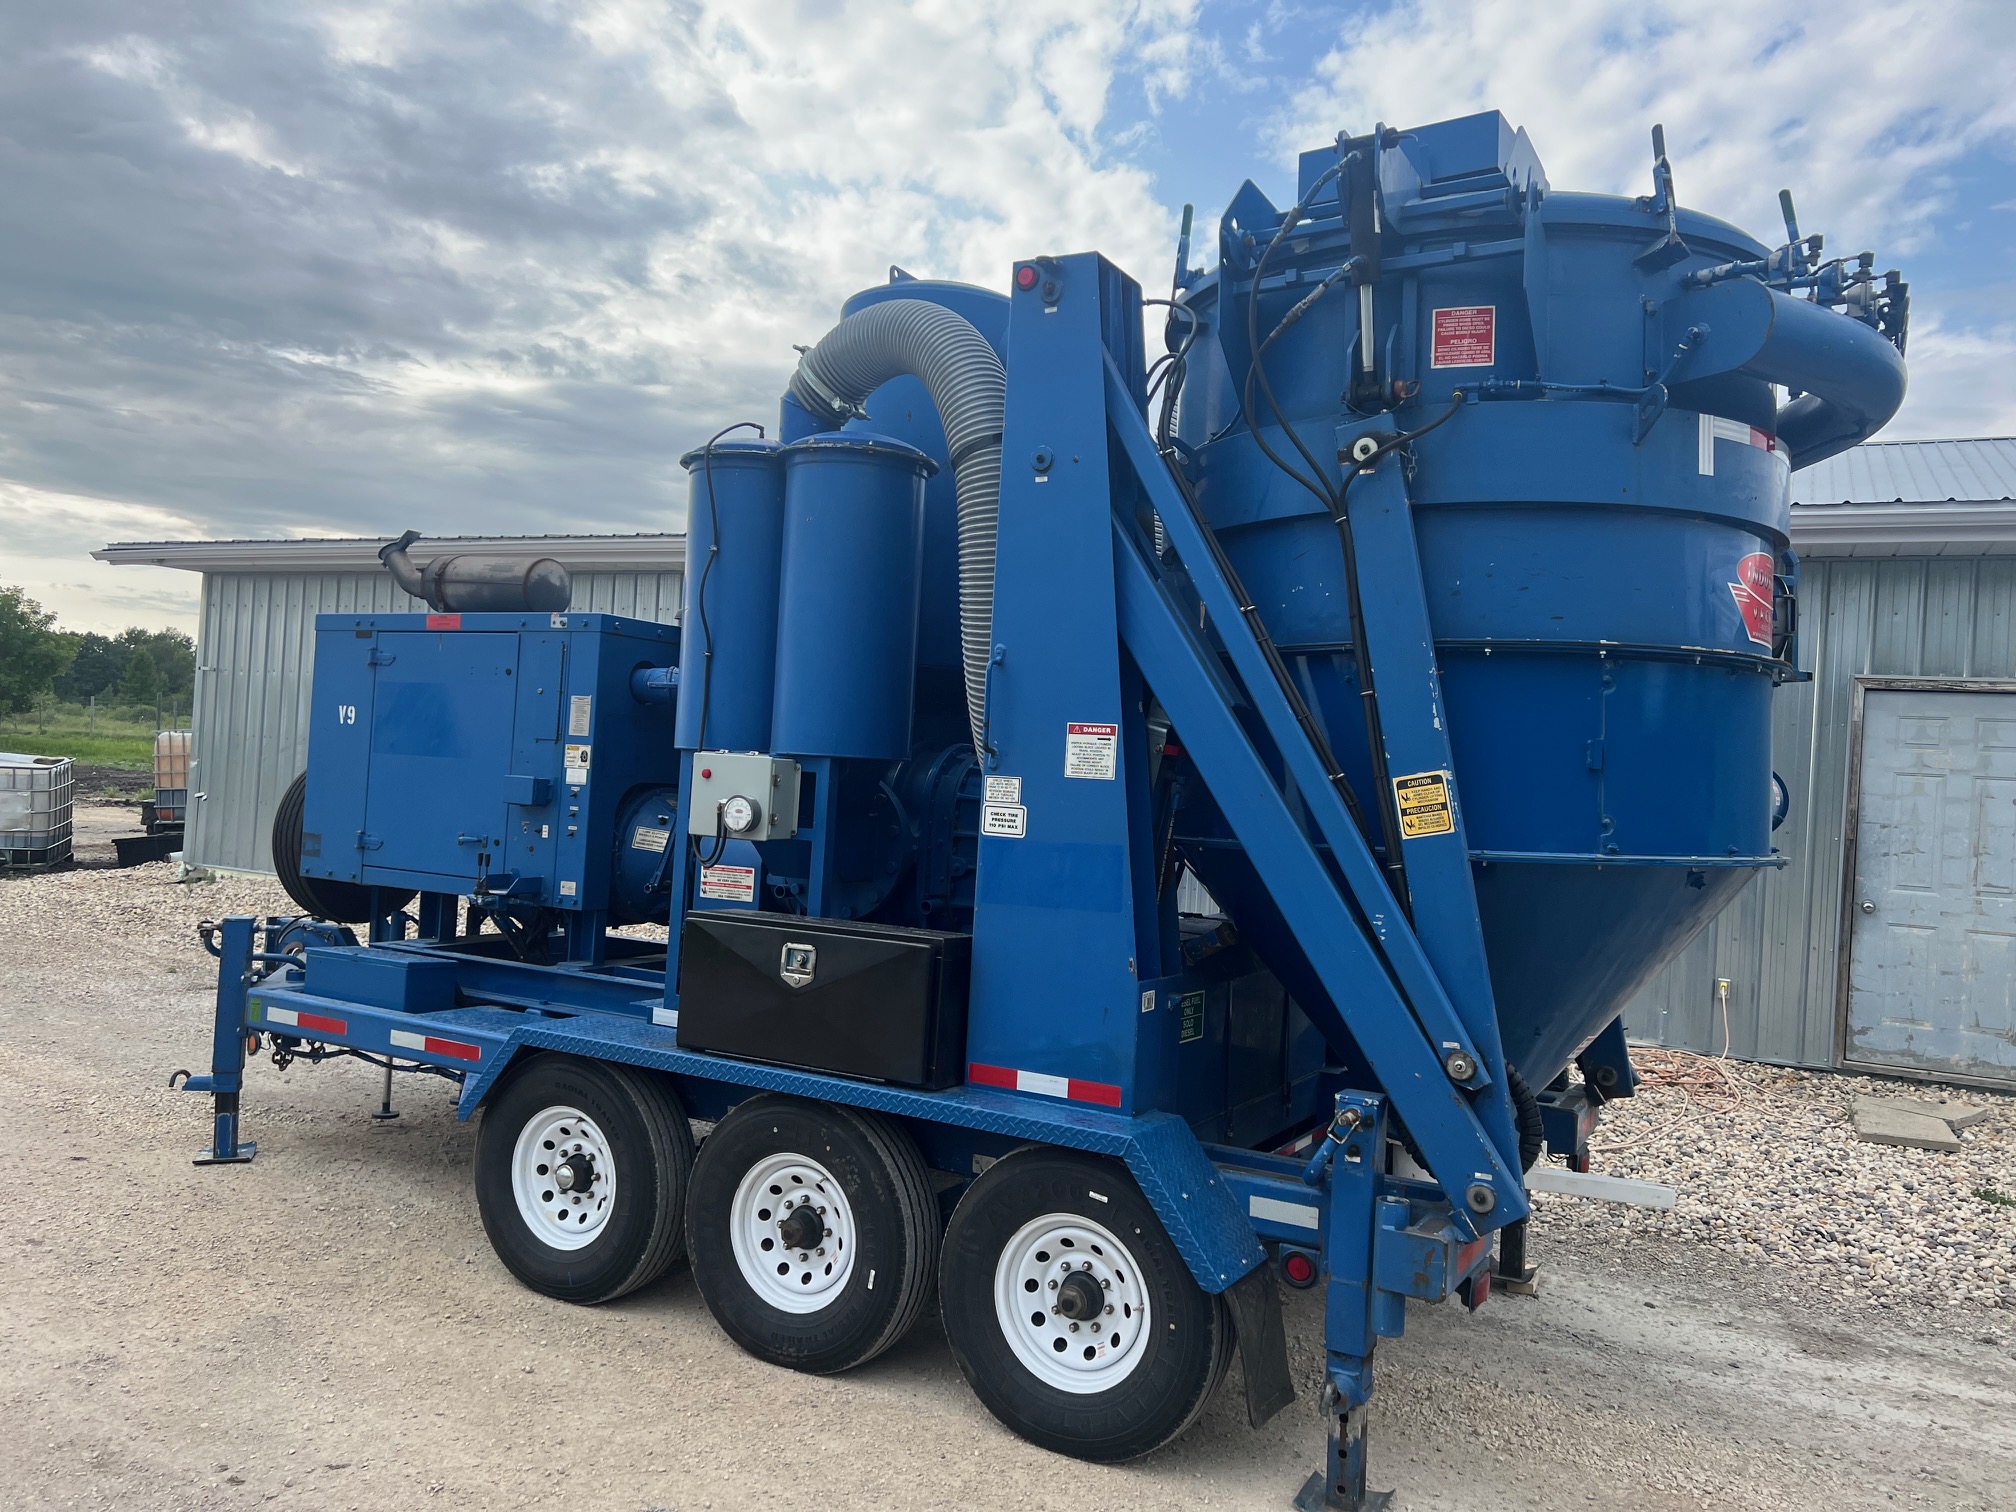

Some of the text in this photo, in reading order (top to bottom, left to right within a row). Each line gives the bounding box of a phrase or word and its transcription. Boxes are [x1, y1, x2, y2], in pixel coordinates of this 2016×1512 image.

[1408, 778, 1432, 787] CAUTION
[1407, 804, 1442, 814] PRECAUCION
[1184, 1007, 1194, 1016] ONLY
[1181, 1028, 1194, 1038] DIESEL
